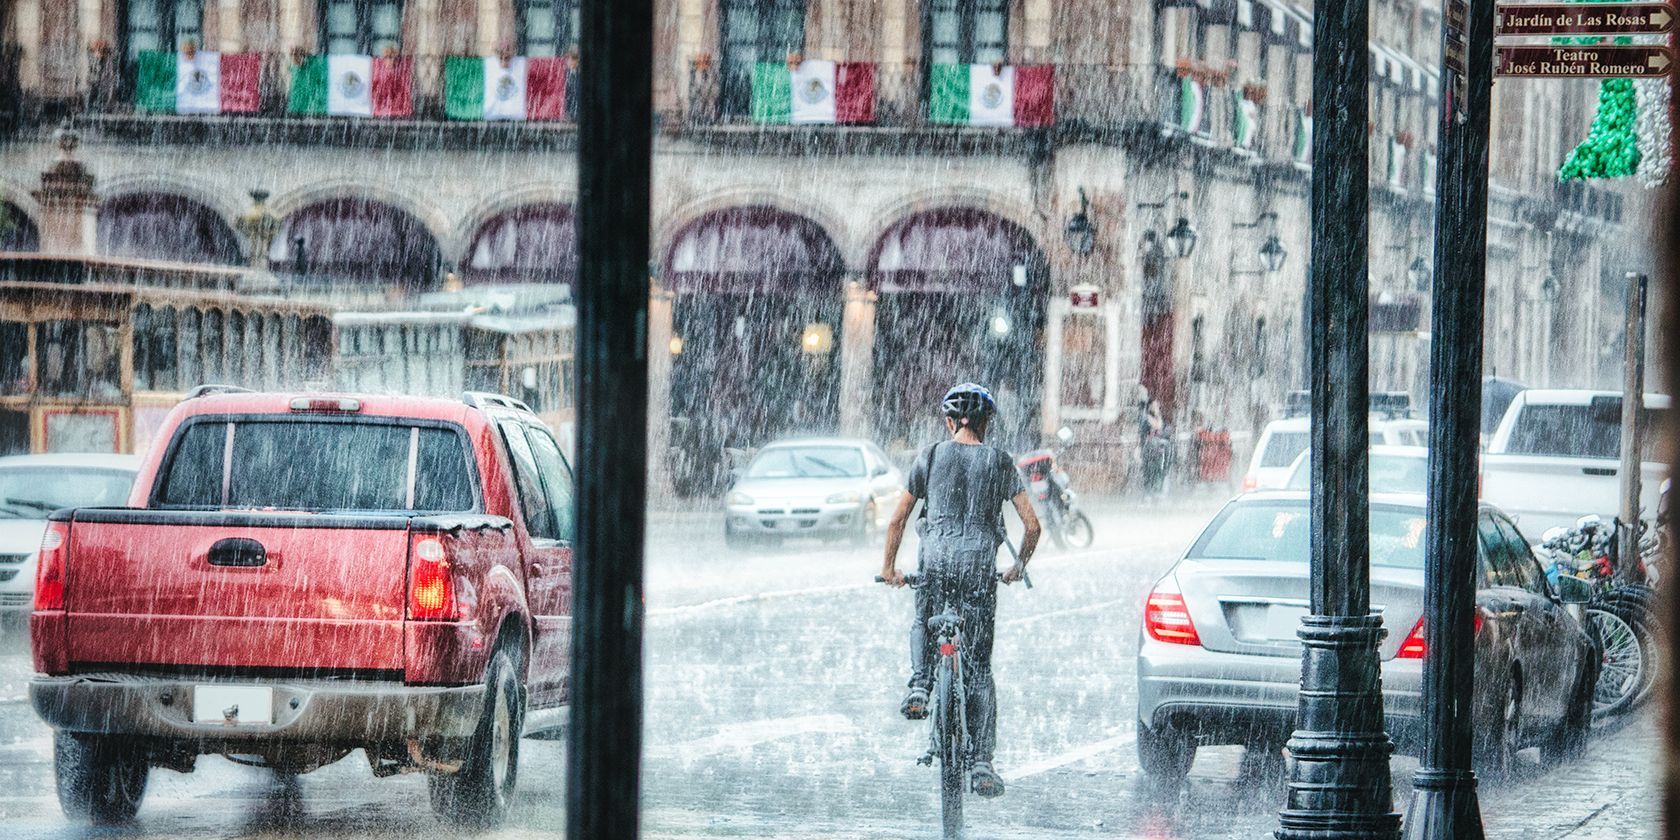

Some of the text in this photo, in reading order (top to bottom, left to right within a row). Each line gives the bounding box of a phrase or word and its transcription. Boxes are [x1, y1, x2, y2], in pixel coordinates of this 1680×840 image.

[1507, 13, 1646, 26] Jardín de Las Rosas
[1553, 49, 1598, 61] Teatro
[1506, 61, 1645, 74] José Rubén Romero
